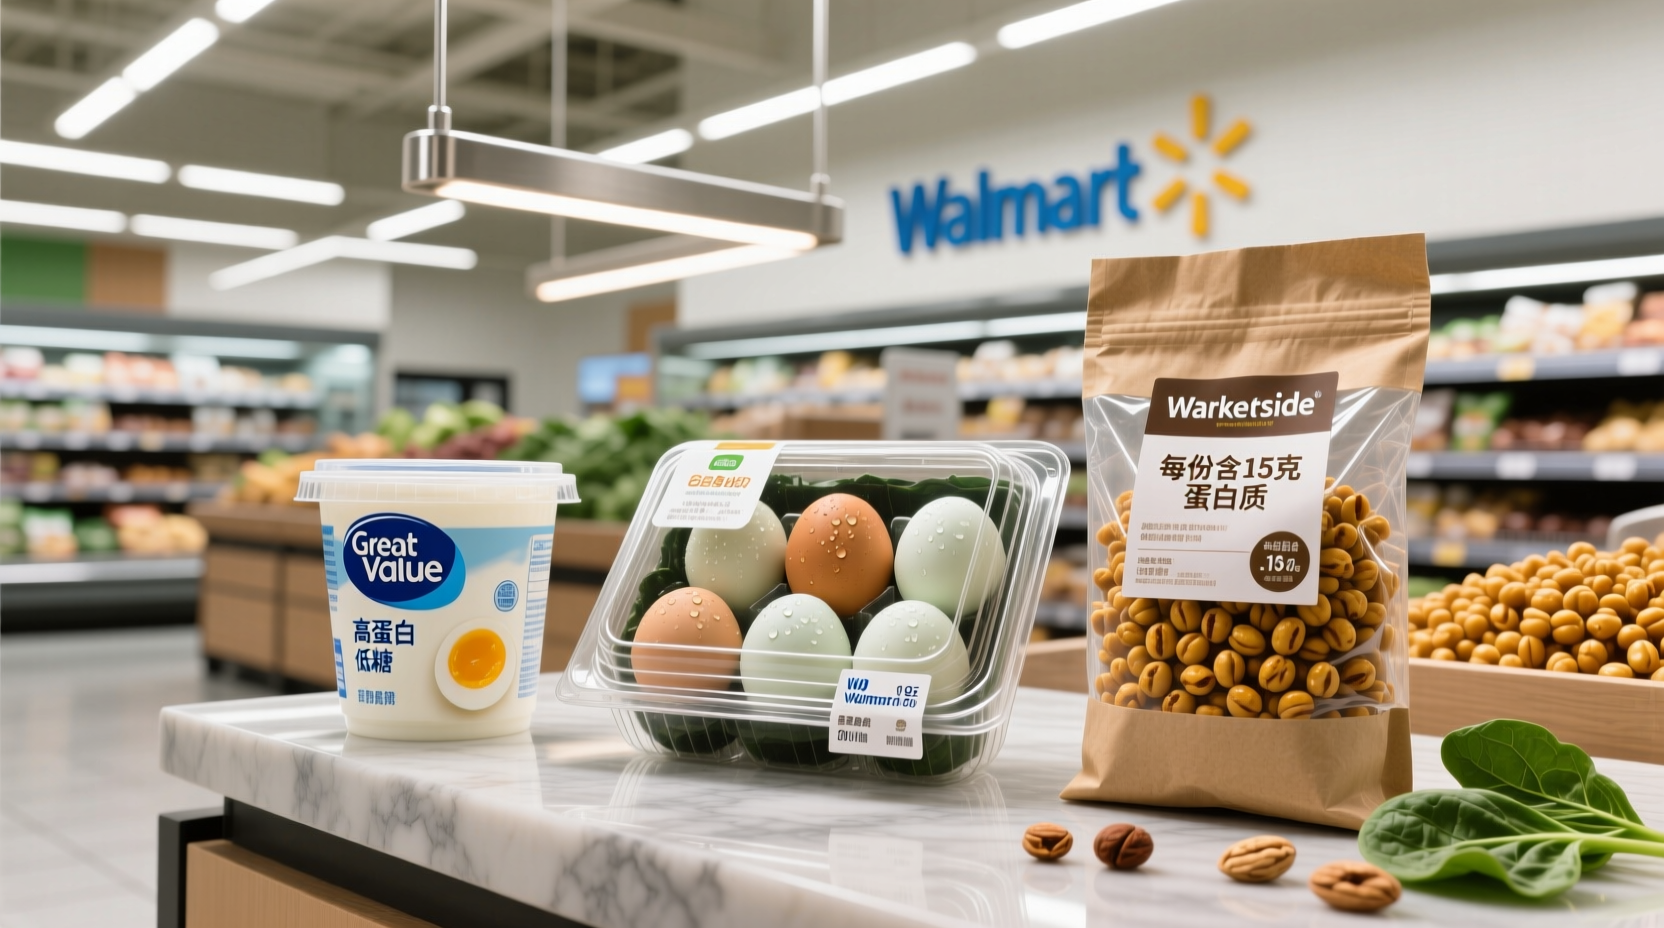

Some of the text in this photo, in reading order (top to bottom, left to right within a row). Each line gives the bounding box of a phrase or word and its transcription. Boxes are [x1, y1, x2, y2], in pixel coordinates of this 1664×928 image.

[891, 142, 1142, 255] Walmart
[1167, 391, 1315, 420] Warketside
[1159, 453, 1303, 482] 每份含15克
[1183, 483, 1268, 511] 蛋白质
[351, 531, 418, 557] Great
[361, 556, 443, 583] Value
[352, 617, 415, 647] 高蛋白
[354, 647, 393, 674] 低糖
